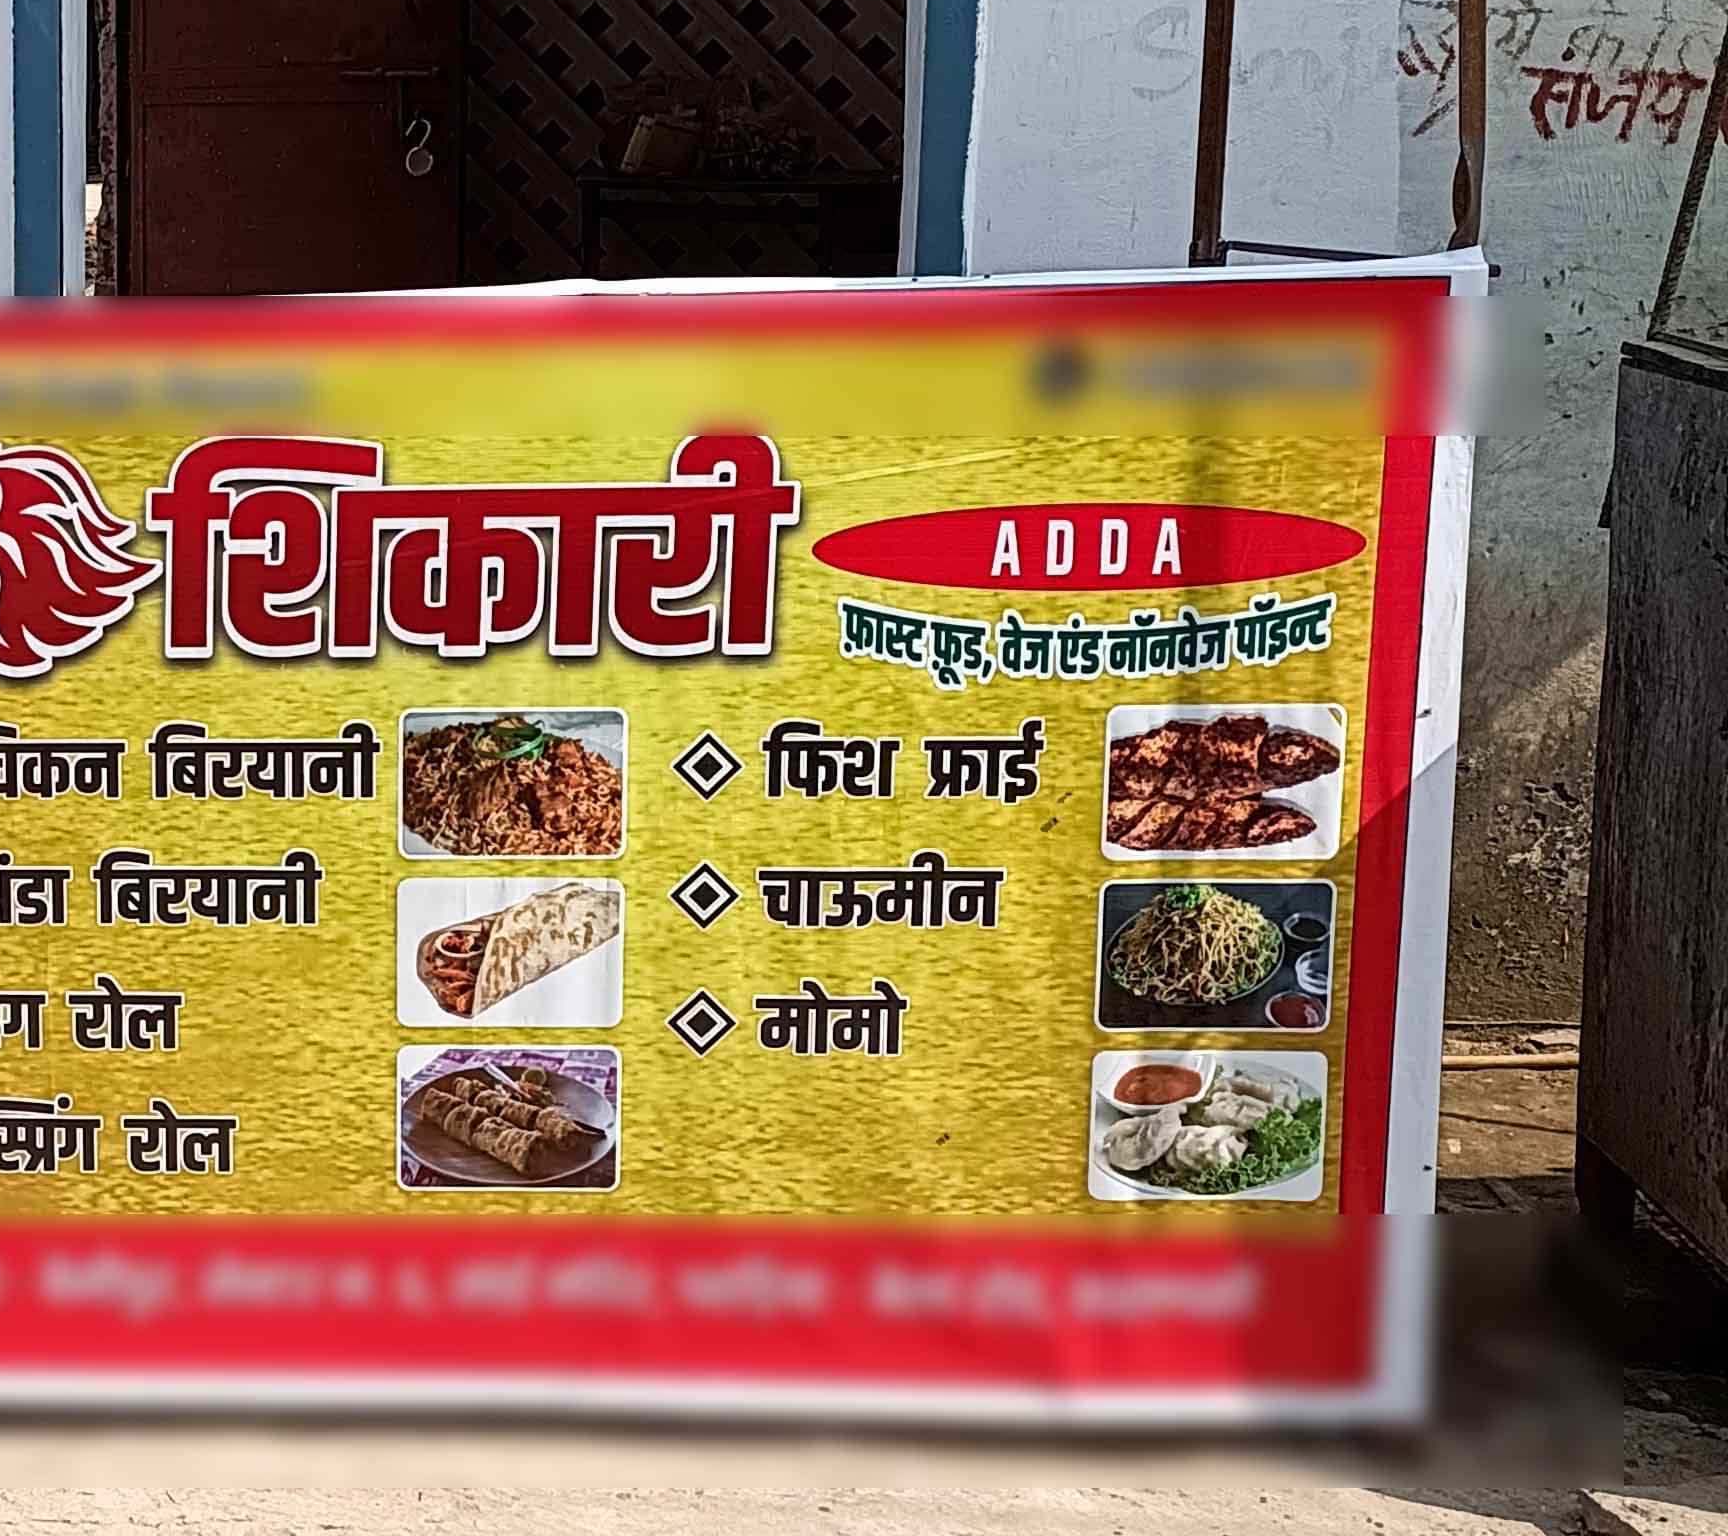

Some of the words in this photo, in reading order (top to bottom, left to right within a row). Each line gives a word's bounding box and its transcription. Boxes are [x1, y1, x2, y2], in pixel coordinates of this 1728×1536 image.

[147, 420, 800, 658] शिकारी
[990, 517, 1182, 578] ADDA
[1000, 615, 1052, 675] वेज
[1056, 618, 1106, 676] एंड
[1107, 612, 1230, 677] नॉनवेज
[147, 722, 382, 800] बिरयानी
[761, 720, 902, 799] फिश
[922, 718, 1046, 805] फ्राई
[92, 848, 324, 926] बिरयानी
[756, 849, 1007, 928] चाऊमीन
[66, 973, 184, 1050] रोल
[753, 978, 910, 1057] मोमो
[121, 1098, 239, 1174] रोल
